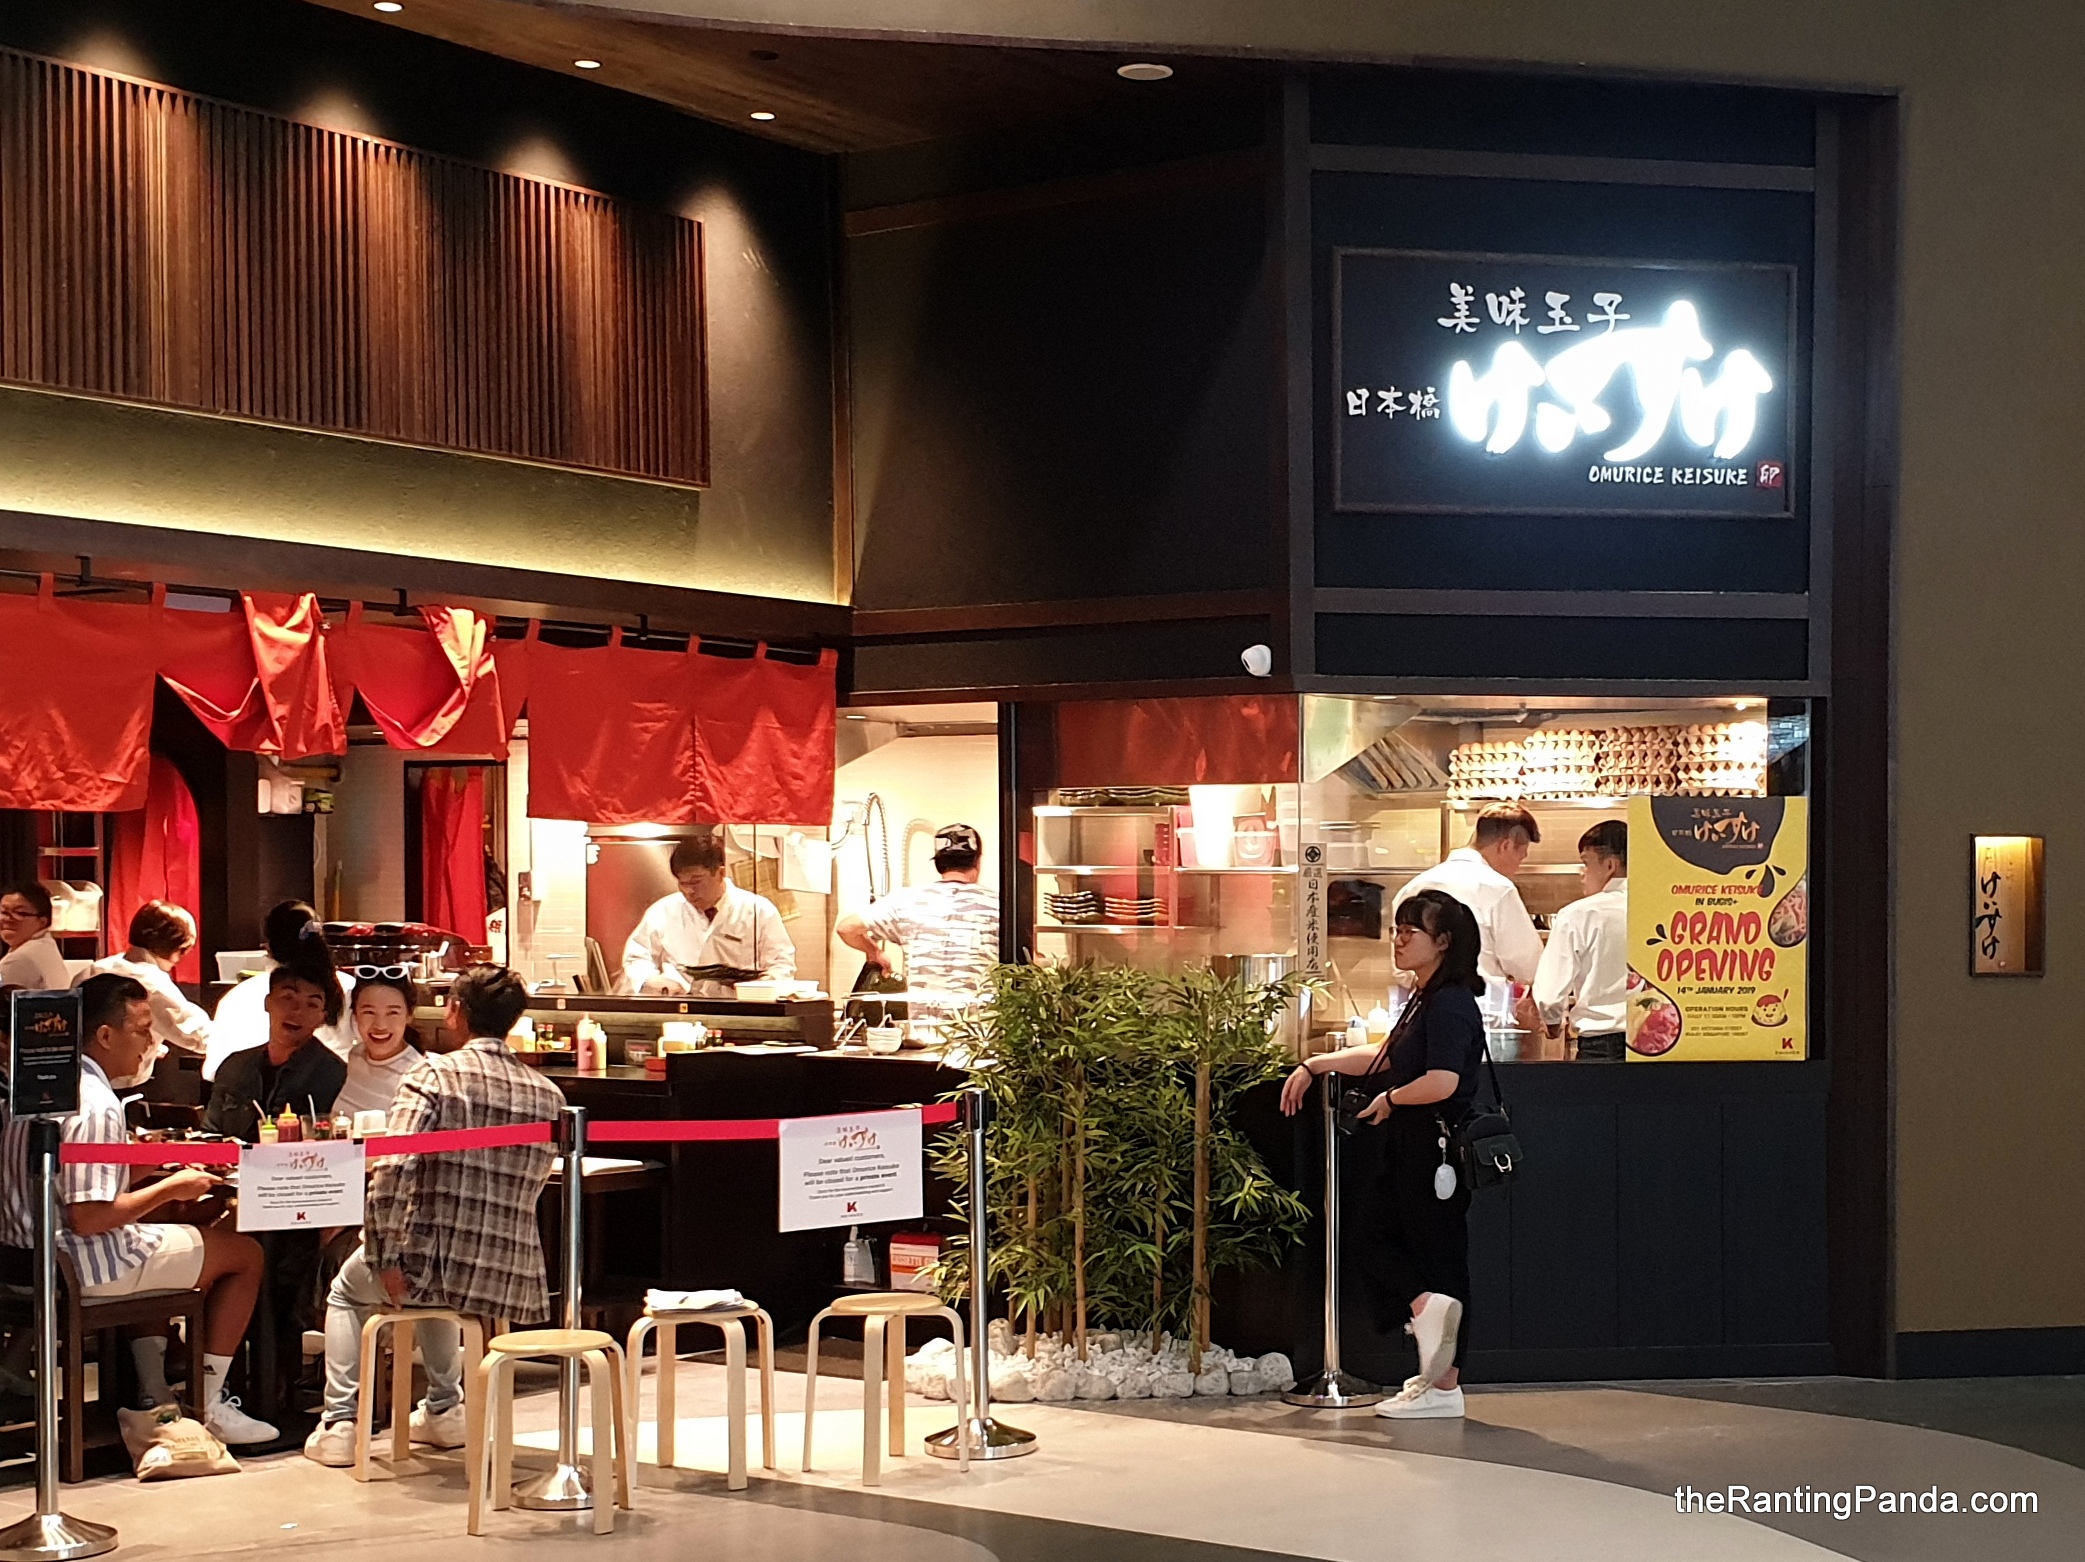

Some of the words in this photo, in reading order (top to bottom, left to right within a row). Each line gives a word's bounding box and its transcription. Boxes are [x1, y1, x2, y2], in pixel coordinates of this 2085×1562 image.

[1437, 282, 1631, 335] 美味玉子
[1346, 386, 1441, 420] 日本橋
[1588, 465, 1664, 484] OMURICE
[1671, 466, 1748, 486] KEISUKE
[1671, 885, 1718, 895] OMURICE
[1720, 885, 1764, 895] KEISUKE
[1695, 898, 1704, 906] IN
[1670, 910, 1762, 945] GRAND
[1656, 947, 1775, 982] OPENING
[1695, 986, 1735, 994] JANUARY
[1737, 986, 1756, 994] 2019
